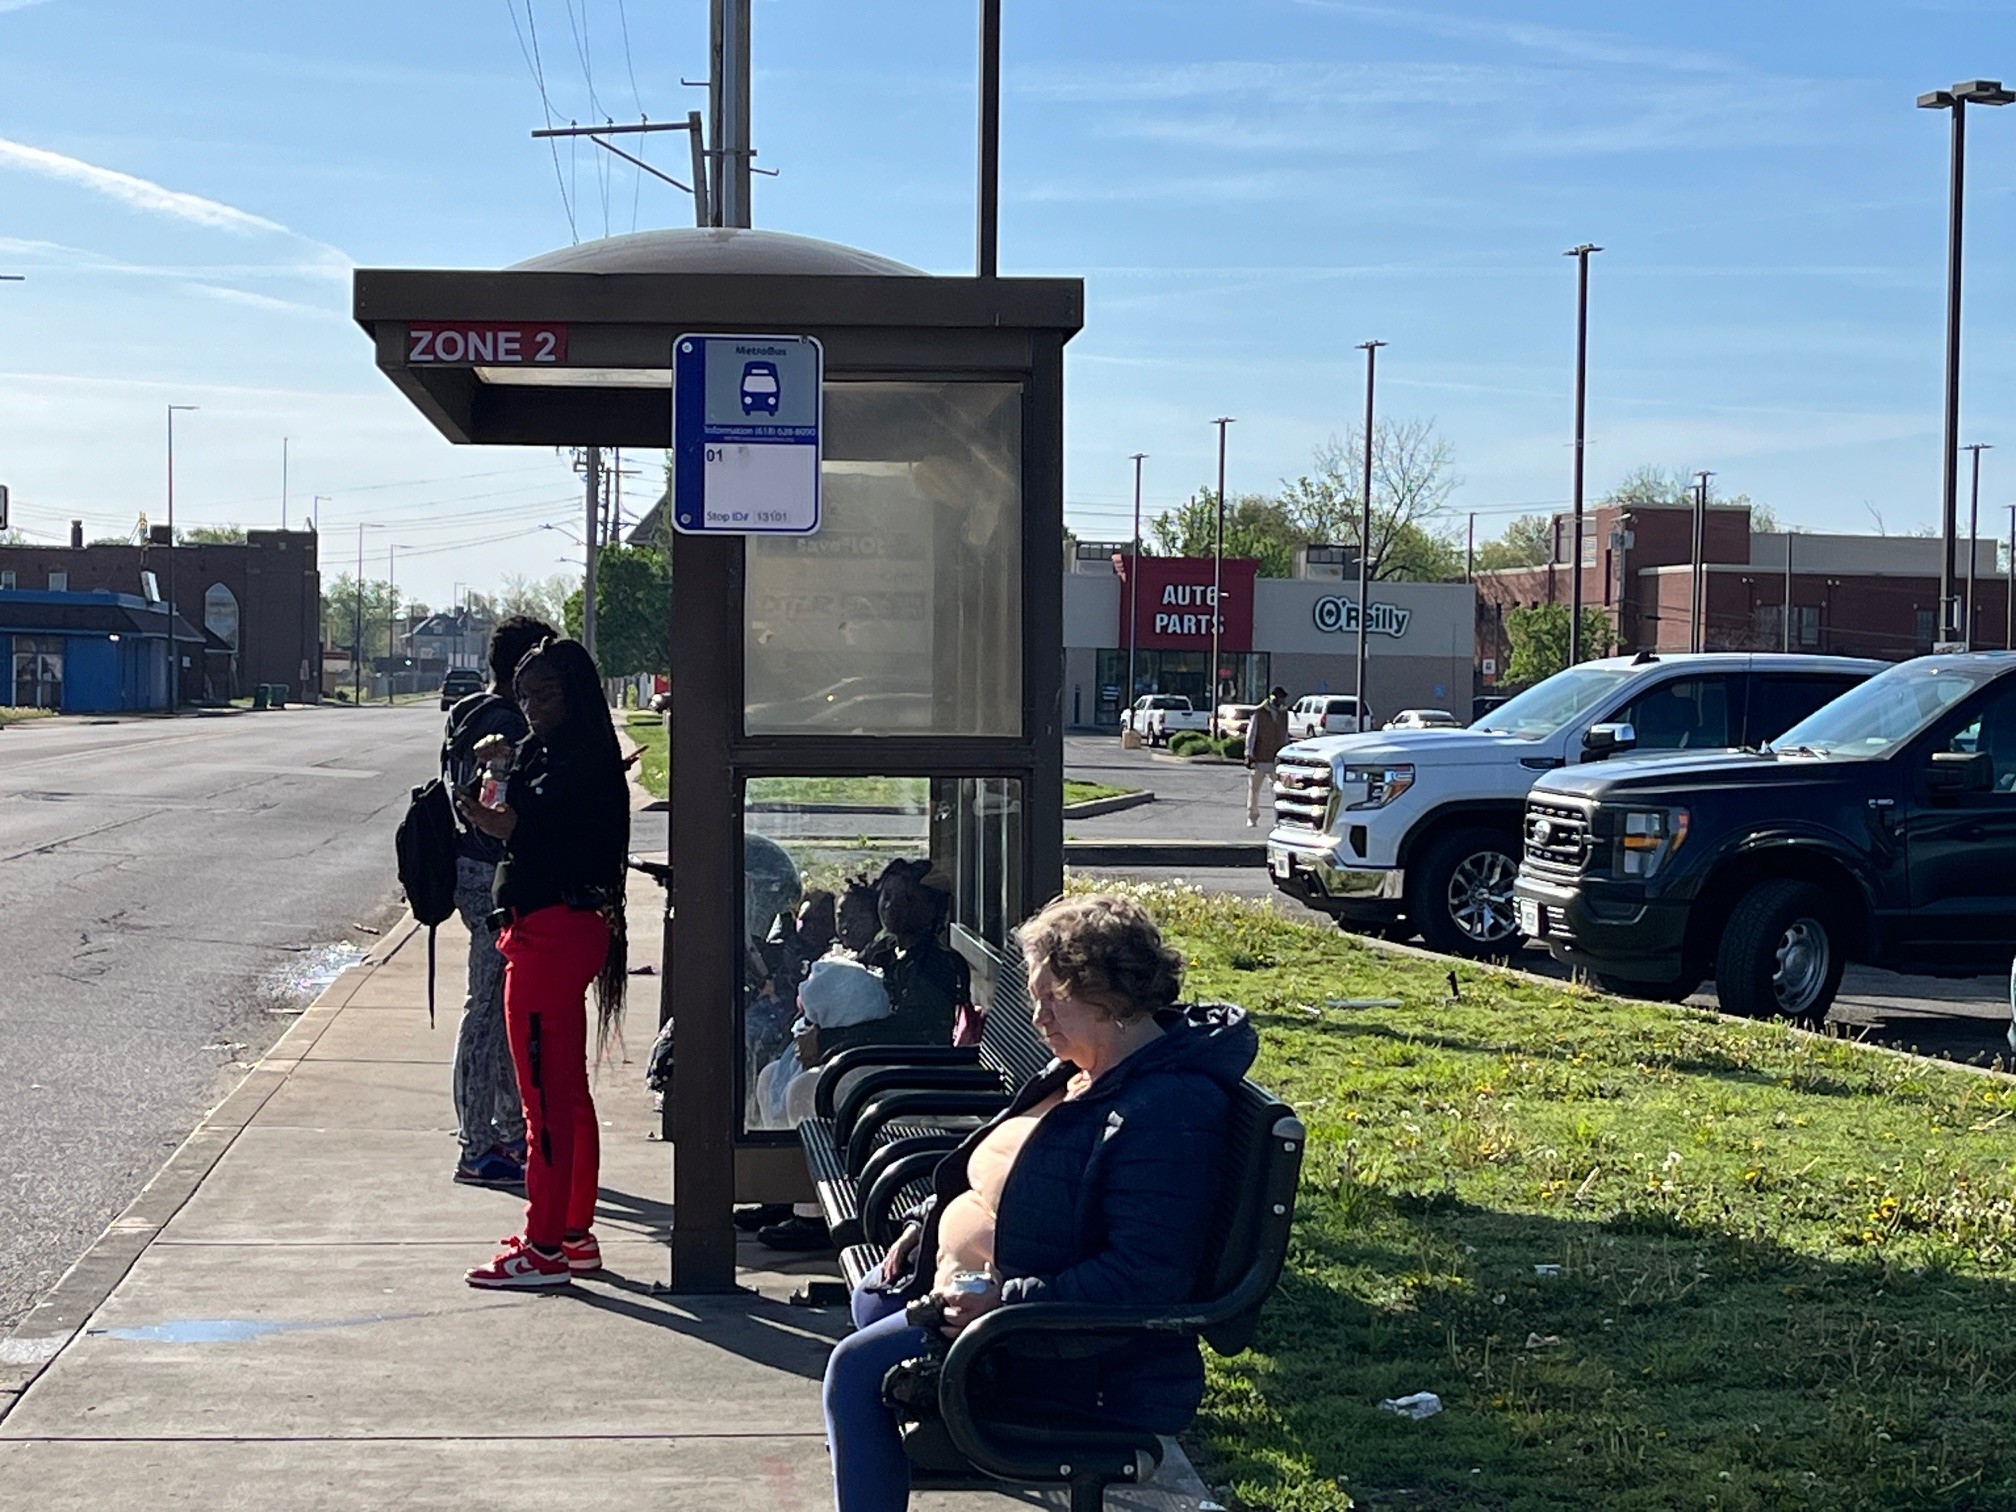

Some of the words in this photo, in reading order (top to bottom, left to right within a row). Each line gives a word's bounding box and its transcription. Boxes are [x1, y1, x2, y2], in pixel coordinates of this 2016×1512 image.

[410, 330, 522, 362] ZONE
[534, 331, 556, 362] 2
[706, 449, 723, 462] 01
[706, 511, 730, 522] Stop
[1162, 584, 1219, 606] AUTO
[1155, 613, 1225, 635] PARTS
